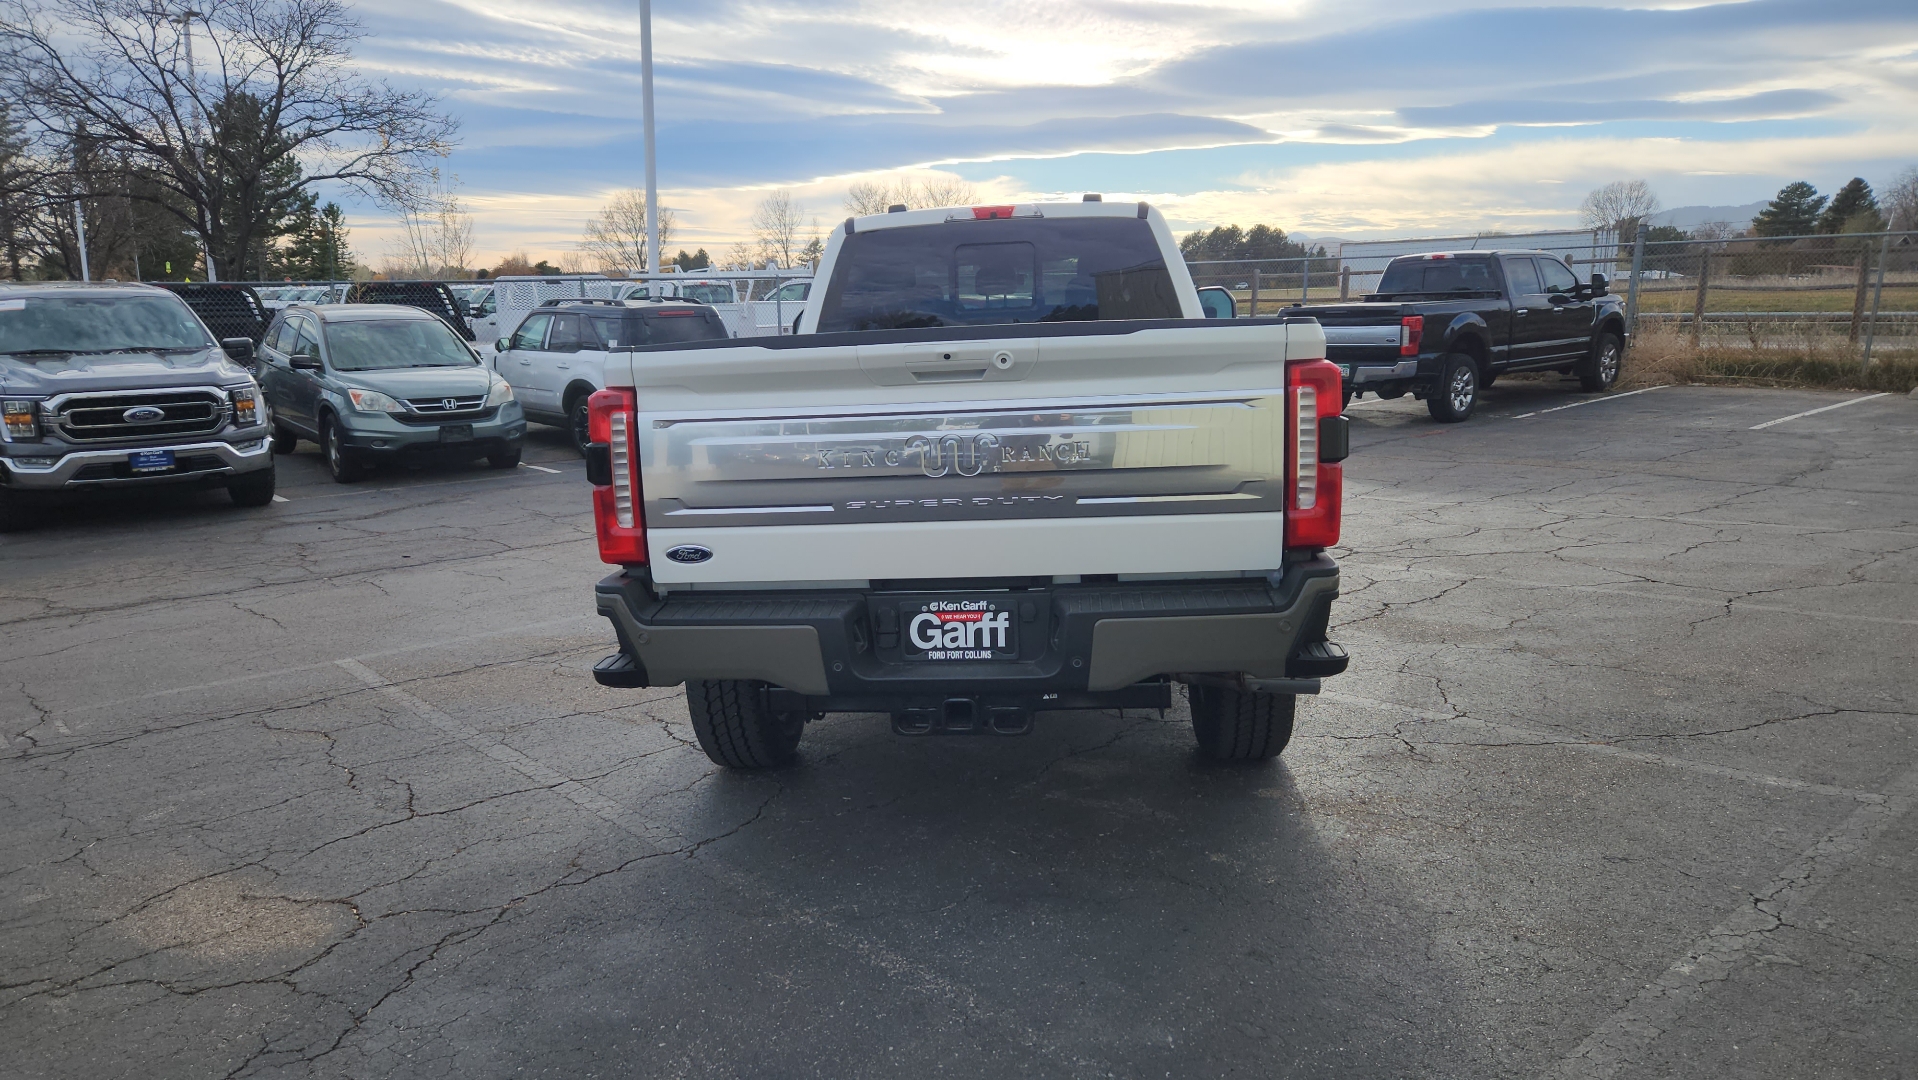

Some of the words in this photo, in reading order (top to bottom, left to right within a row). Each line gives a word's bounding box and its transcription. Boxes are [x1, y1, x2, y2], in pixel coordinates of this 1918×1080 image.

[817, 449, 899, 470] KING
[1001, 440, 1091, 464] RANCH
[846, 497, 963, 510] SUPER
[972, 495, 1064, 506] DUTY
[676, 549, 702, 560] Ford
[939, 601, 960, 611] Ken
[961, 600, 988, 611] Garff
[909, 611, 1010, 650] Garff
[928, 650, 945, 660] FORD
[947, 650, 964, 660] FORT
[964, 650, 992, 660] COLLINS
